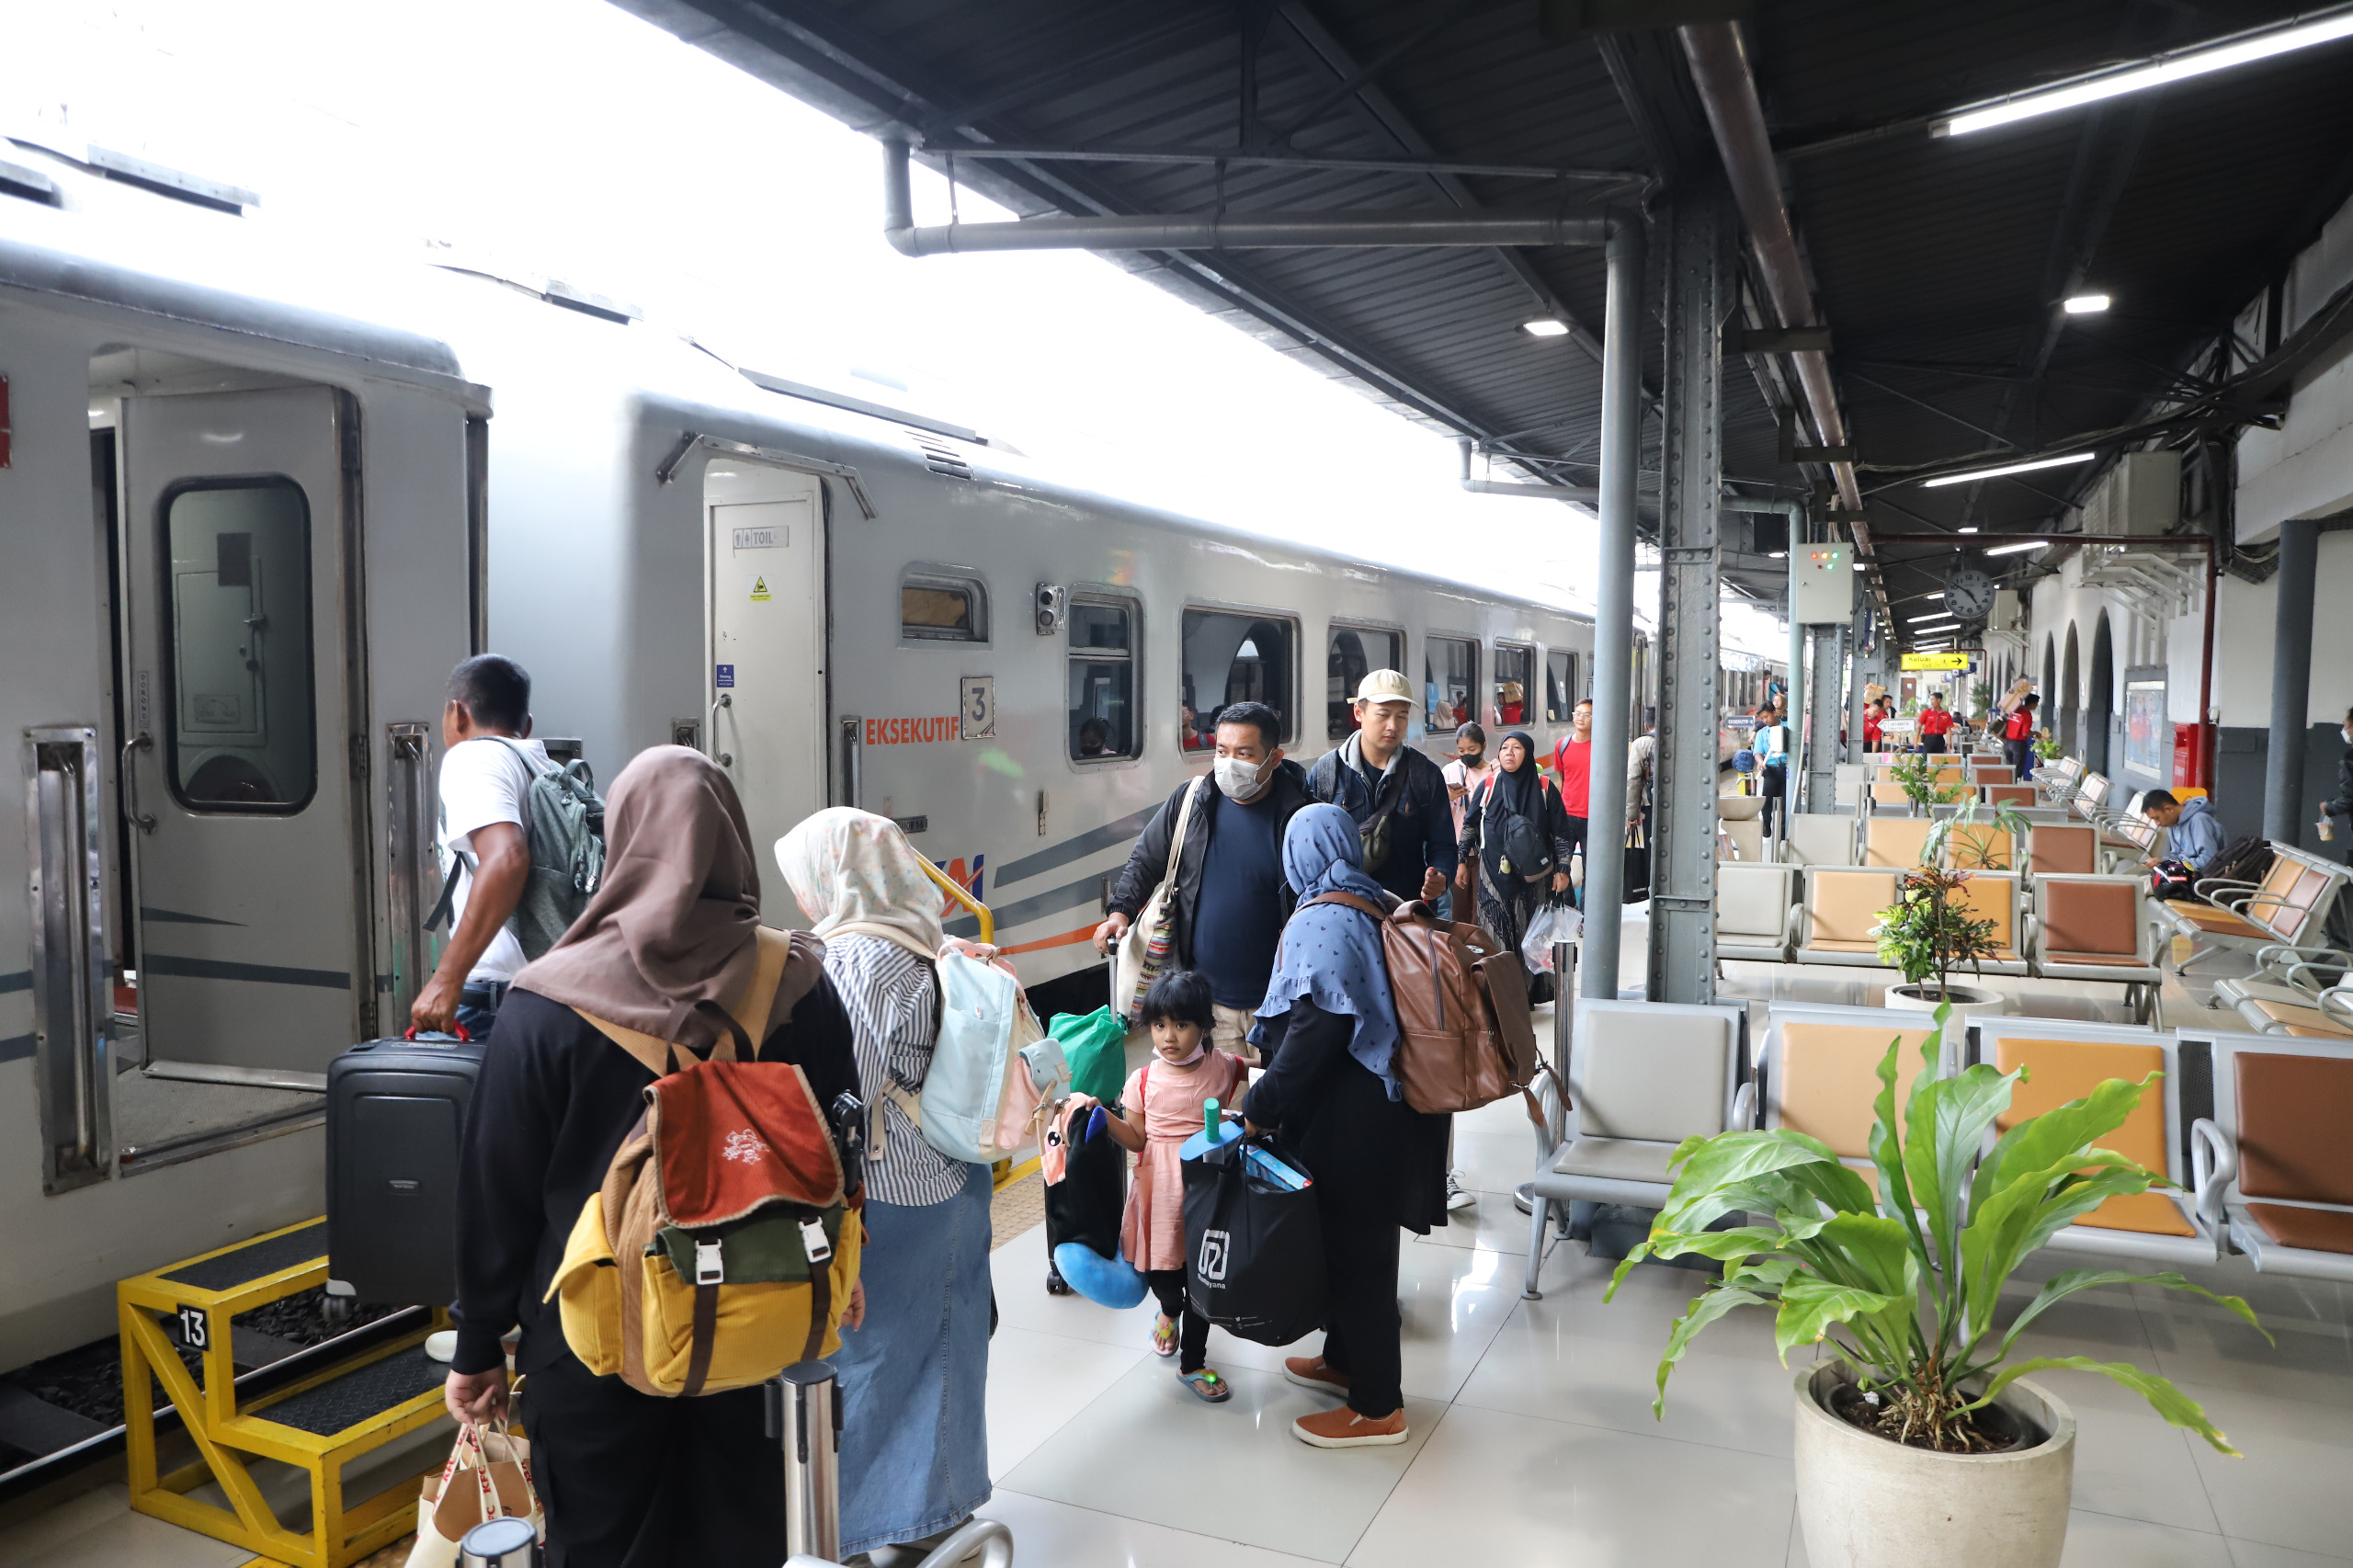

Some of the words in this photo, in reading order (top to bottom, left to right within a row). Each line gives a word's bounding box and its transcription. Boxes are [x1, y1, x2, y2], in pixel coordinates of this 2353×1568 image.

[972, 687, 986, 722] 3
[866, 716, 960, 745] EKSEKUTIF
[180, 1309, 206, 1346] 13
[478, 1464, 491, 1494] KFC
